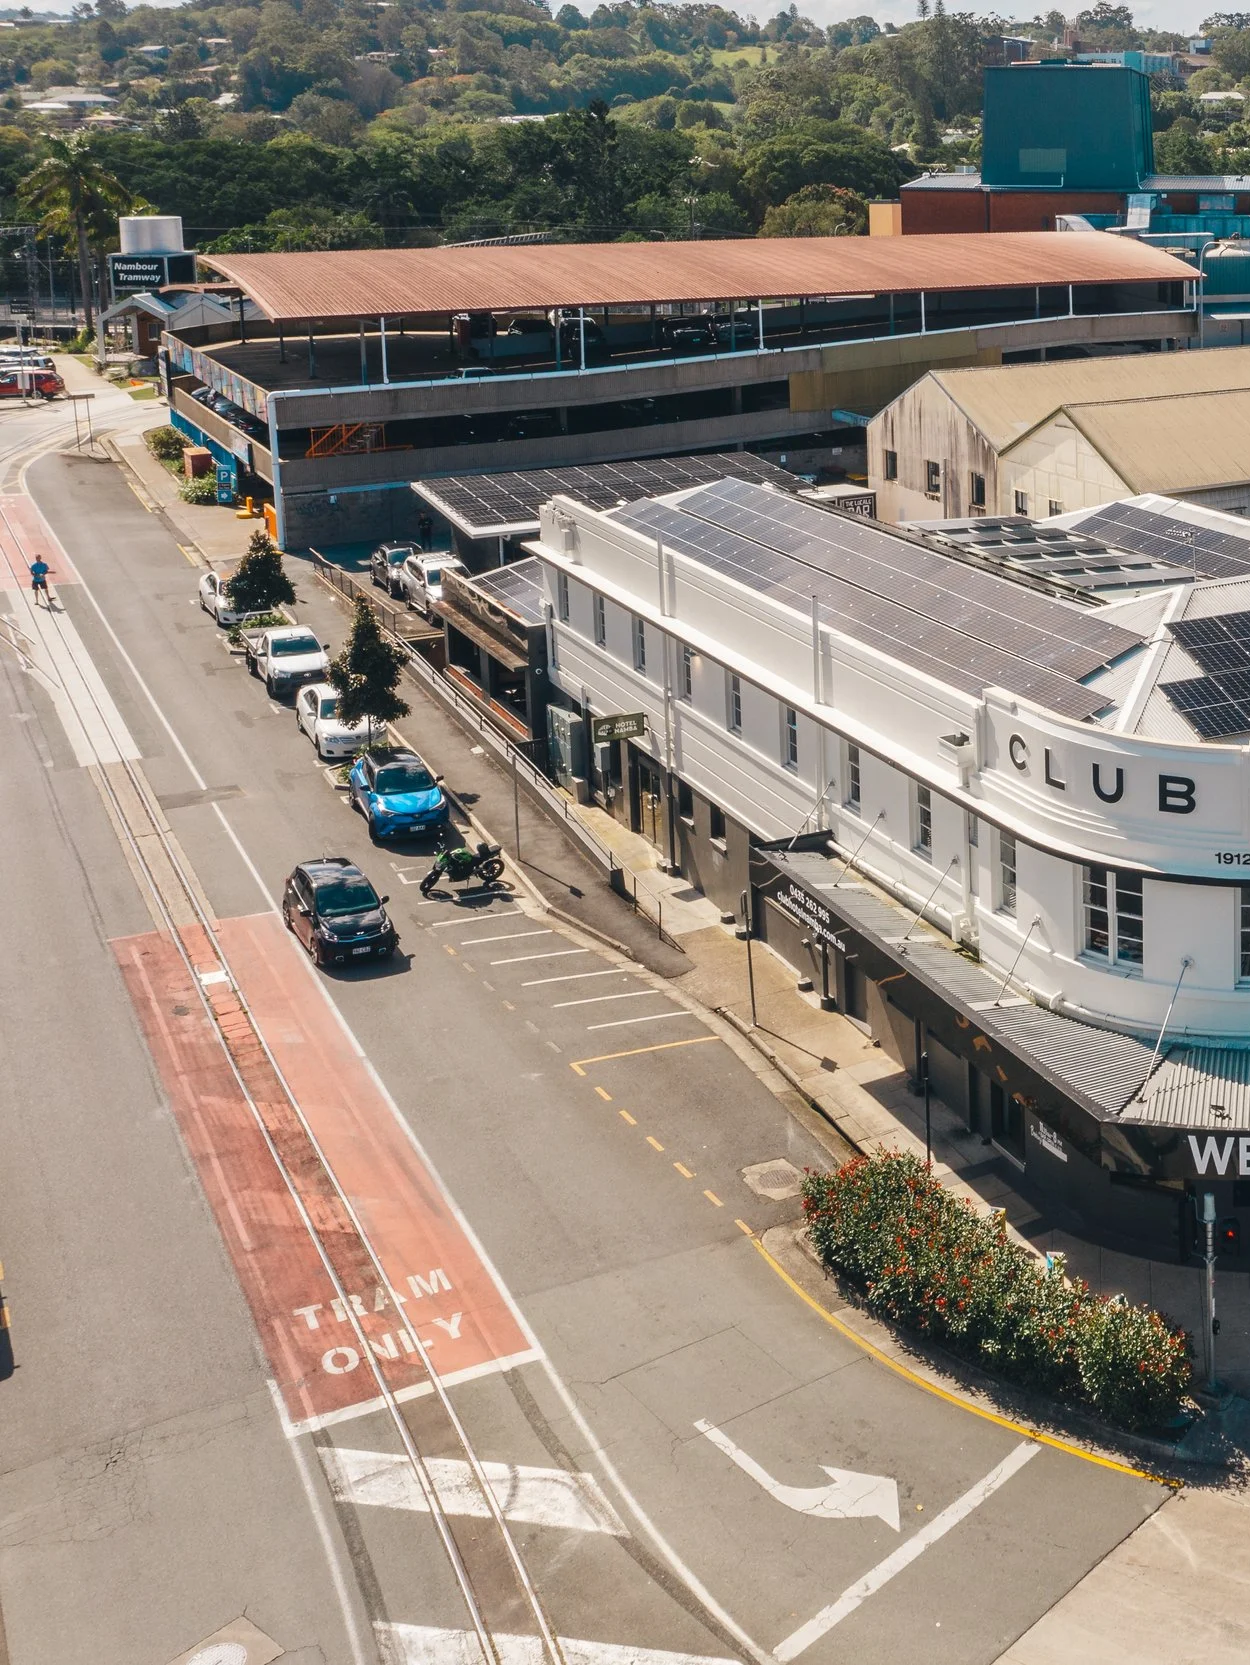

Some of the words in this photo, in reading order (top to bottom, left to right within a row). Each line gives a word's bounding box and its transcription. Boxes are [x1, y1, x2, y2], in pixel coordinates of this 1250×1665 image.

[114, 262, 158, 271] Nambour
[118, 273, 161, 283] Tramway
[220, 471, 228, 481] P
[614, 725, 638, 734] NAMBA
[615, 720, 637, 729] HOTEL
[1009, 733, 1196, 815] CLUB
[789, 884, 804, 904] 0435
[805, 896, 817, 914] 262
[817, 906, 830, 924] 995
[777, 891, 846, 952] clubhotelnamba.com.au
[293, 1268, 452, 1330] TRAM
[321, 1311, 463, 1375] ONLY
